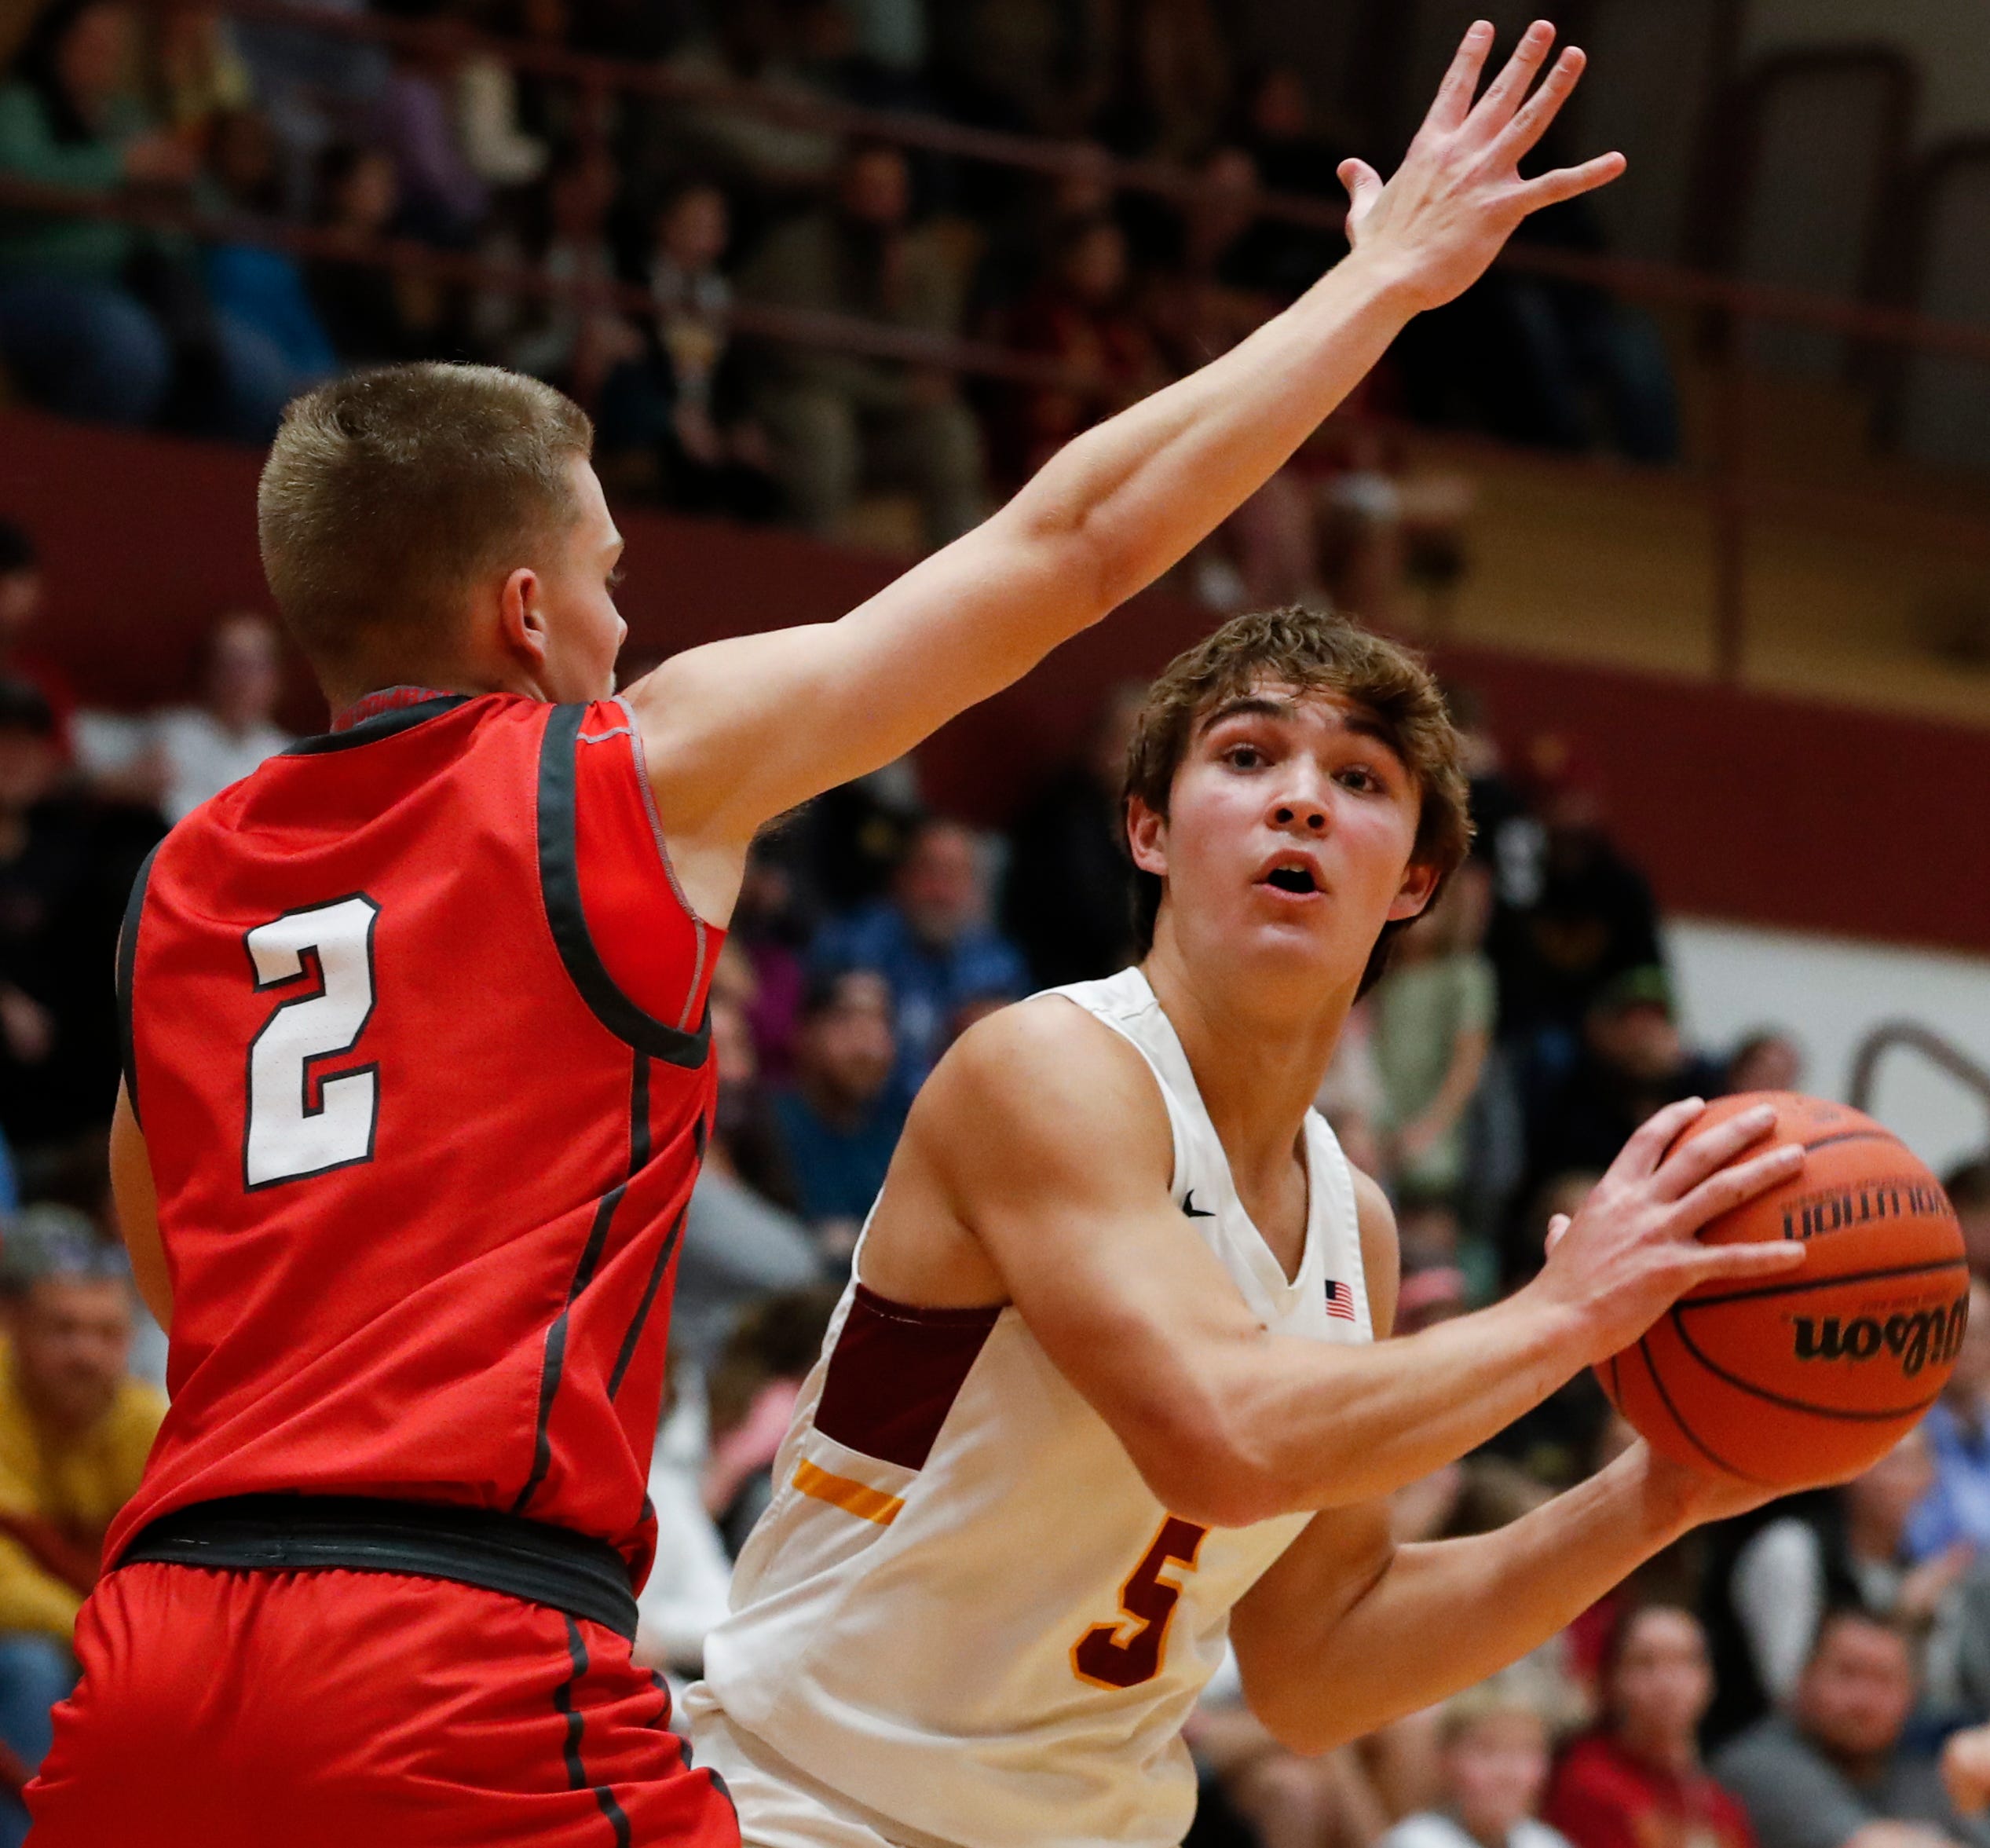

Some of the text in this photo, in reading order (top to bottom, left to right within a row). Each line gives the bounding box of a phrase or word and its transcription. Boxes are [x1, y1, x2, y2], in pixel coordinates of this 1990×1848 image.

[244, 891, 382, 1194] 2
[1793, 1294, 1970, 1378] Wilson
[1070, 1513, 1213, 1691] 5
